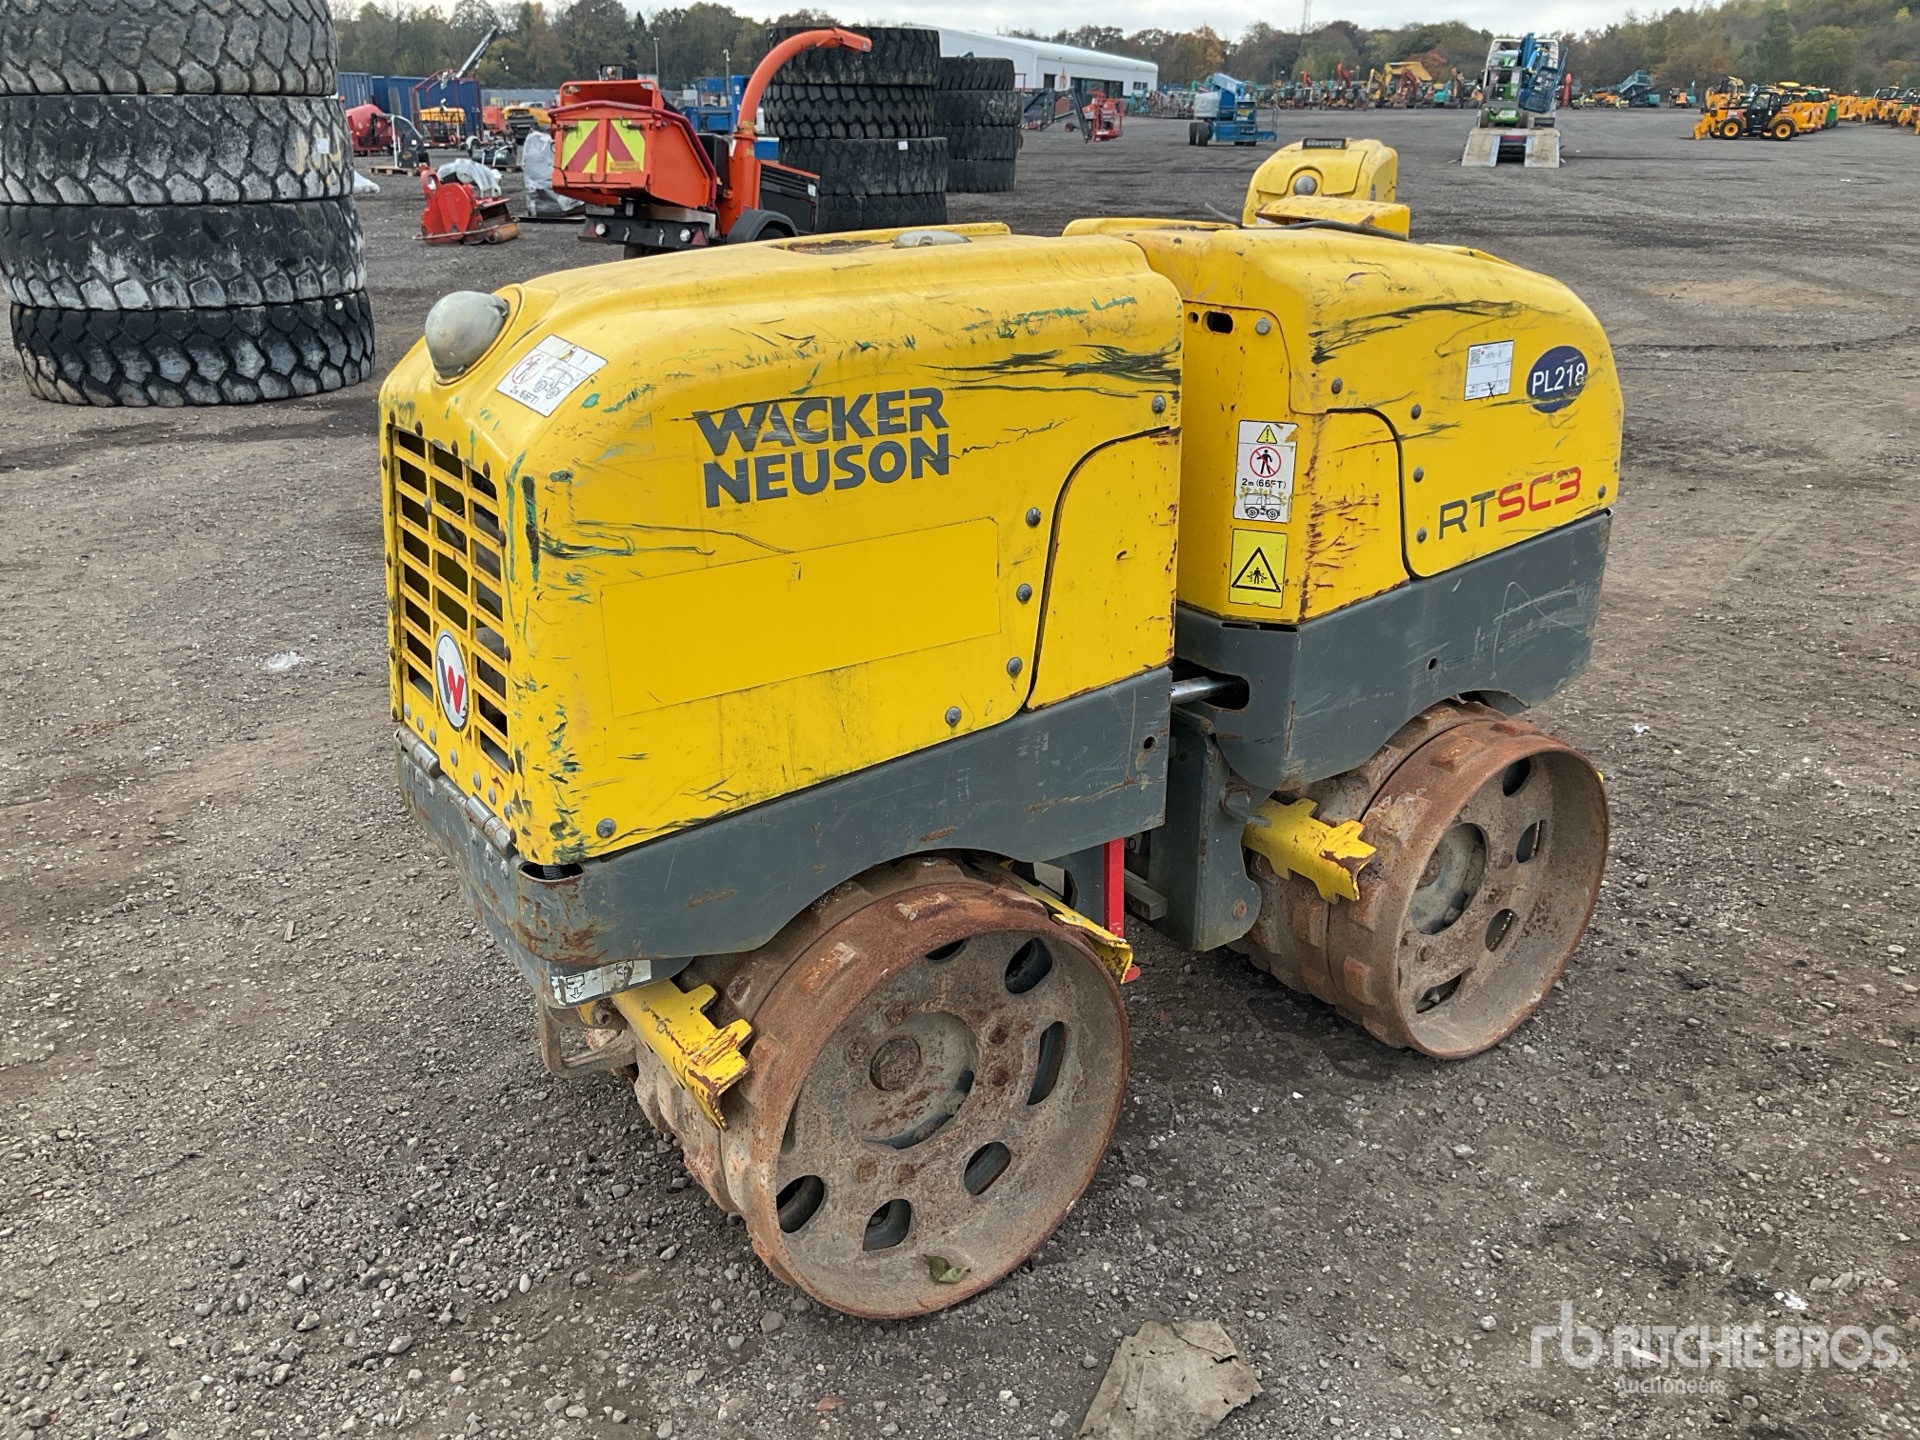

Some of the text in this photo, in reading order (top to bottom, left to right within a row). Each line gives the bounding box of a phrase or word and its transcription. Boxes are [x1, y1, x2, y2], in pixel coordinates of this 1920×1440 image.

[1531, 362, 1586, 395] PL218
[692, 387, 949, 456] WACKER
[703, 433, 949, 508] NEUSON
[1438, 466, 1582, 540] RTSC3
